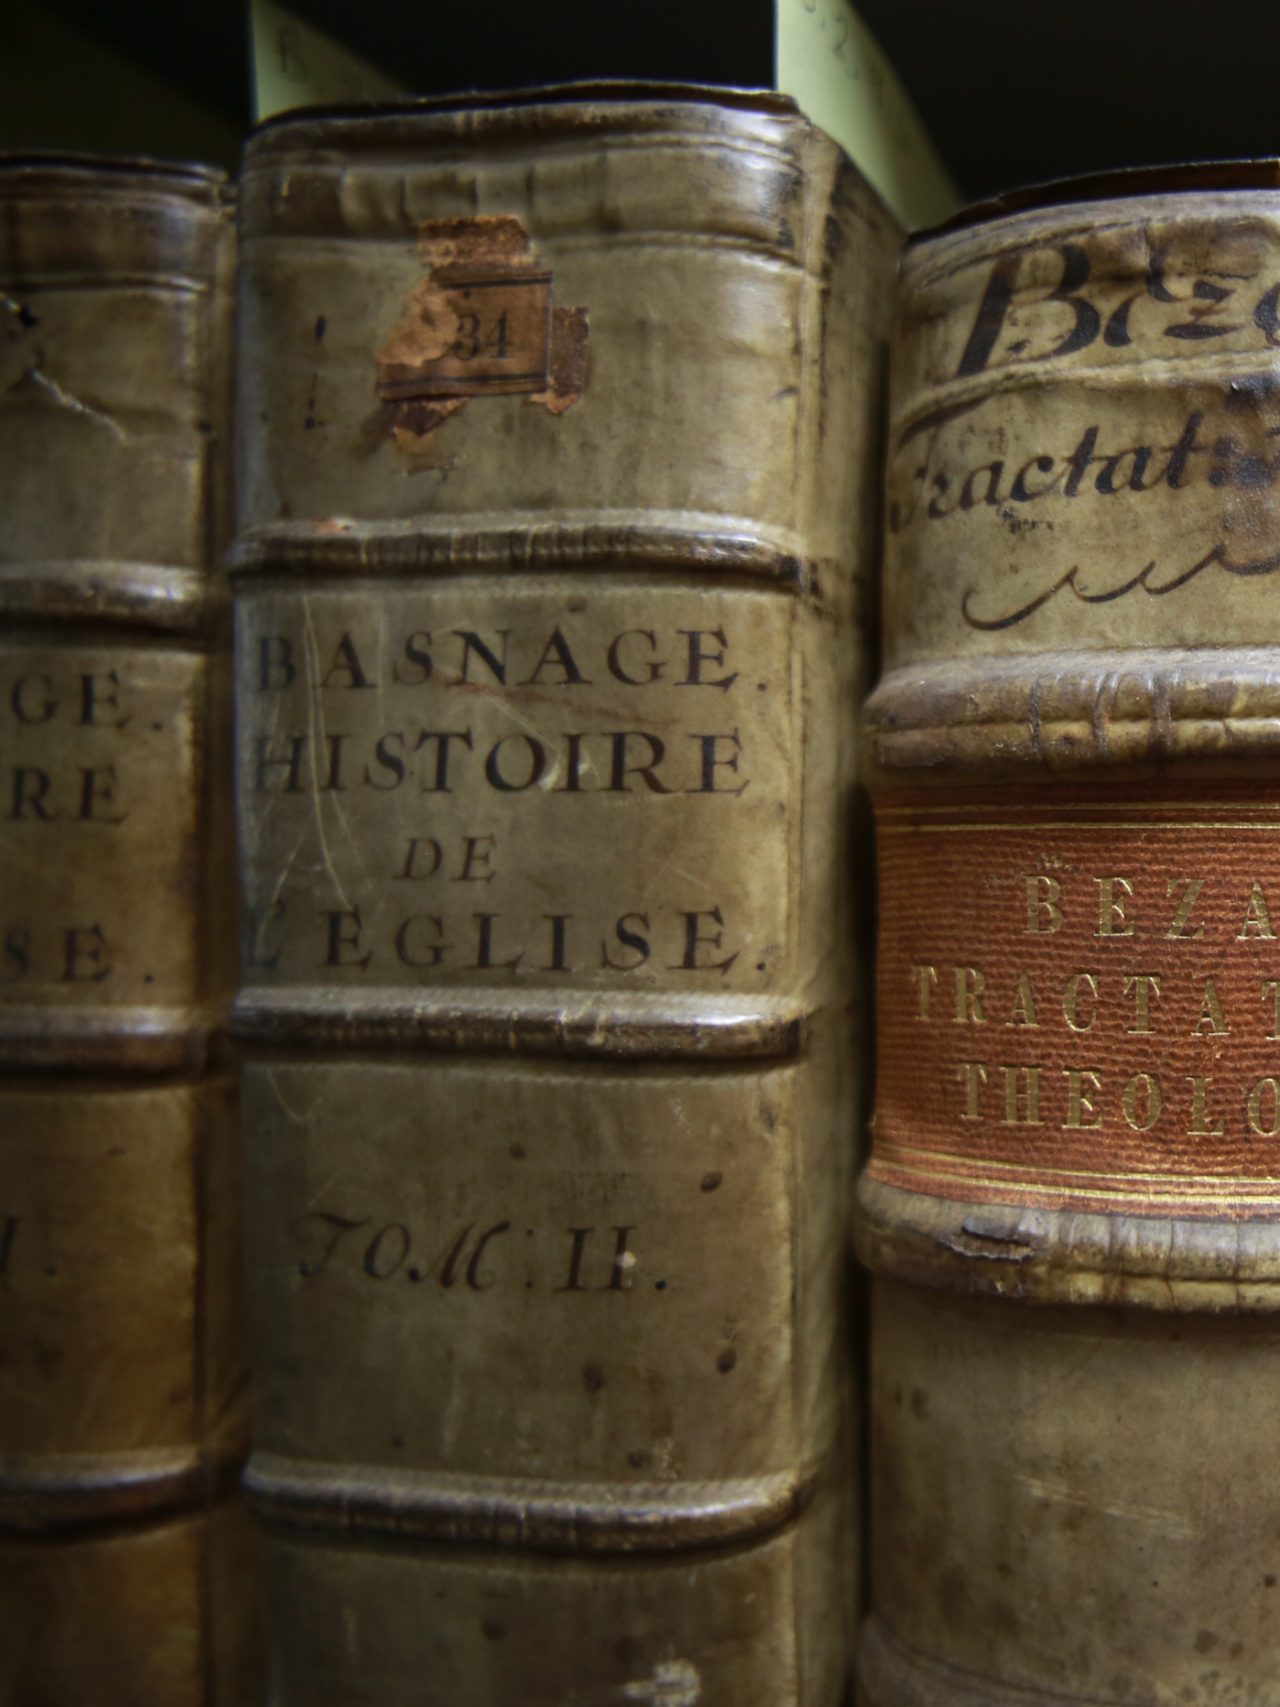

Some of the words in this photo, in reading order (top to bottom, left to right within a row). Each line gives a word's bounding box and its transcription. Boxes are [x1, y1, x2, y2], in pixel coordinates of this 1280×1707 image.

[256, 626, 769, 692] BASNAGE.
[7, 765, 128, 823] RE
[251, 726, 751, 796] HISTOIRE
[392, 833, 498, 885] DE
[1023, 874, 1279, 940] BEZA
[554, 1224, 668, 1292] II.
